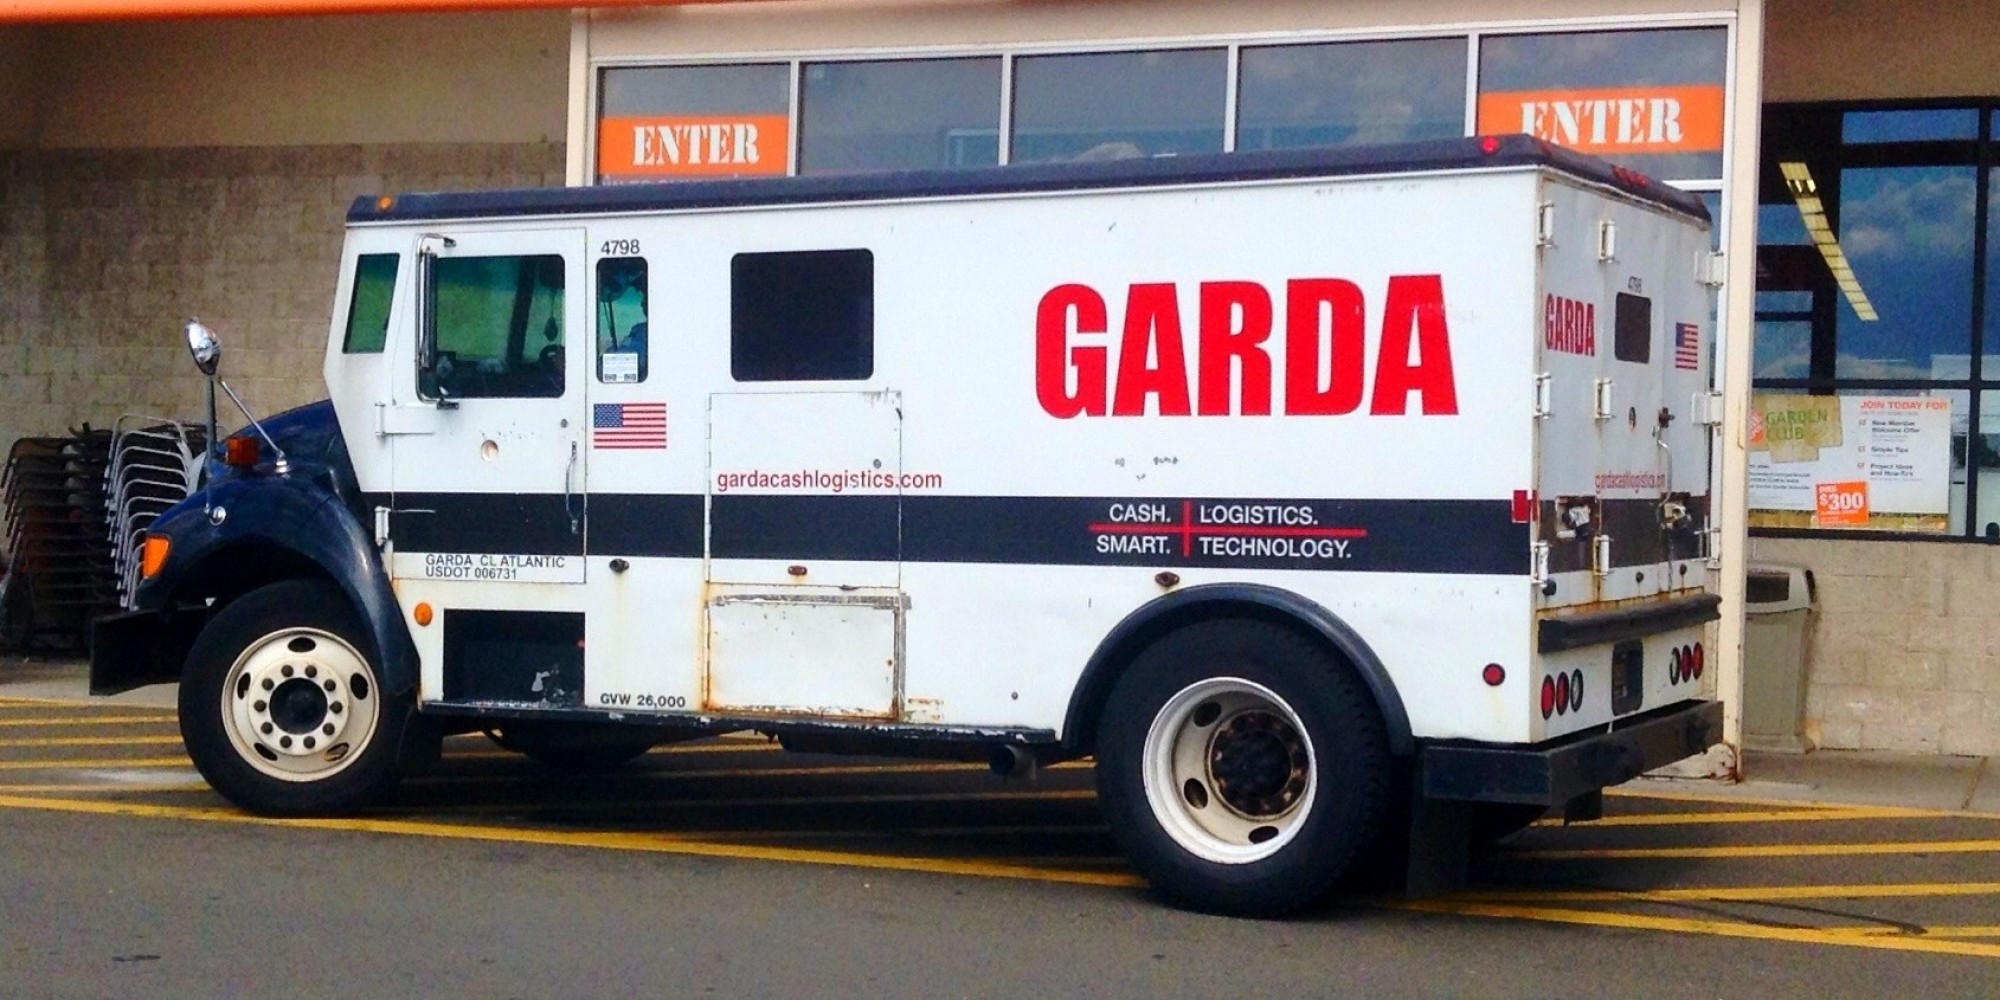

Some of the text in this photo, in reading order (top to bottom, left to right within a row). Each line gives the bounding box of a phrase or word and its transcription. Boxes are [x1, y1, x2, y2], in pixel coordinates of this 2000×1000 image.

[1520, 97, 1684, 145] ENTER
[632, 123, 760, 166] ENTER
[600, 238, 641, 256] 4798
[1545, 292, 1596, 358] GARDA
[1035, 273, 1460, 420] GARDA
[1860, 400, 1885, 410] JOIN
[1888, 400, 1921, 410] TODAY
[1766, 406, 1828, 424] GARDEN
[1766, 423, 1804, 441] CLUB
[717, 469, 943, 492] gardacashlogistics.com
[1819, 492, 1865, 511] $300
[1109, 503, 1319, 525] CASH. LOGISTICS.
[1096, 535, 1352, 558] SMART. TECHNOLOGY.
[425, 553, 566, 569] GARDA CL ATLANTIC
[425, 566, 518, 580] USDOT 006731
[600, 692, 687, 709] GVW 26,000
